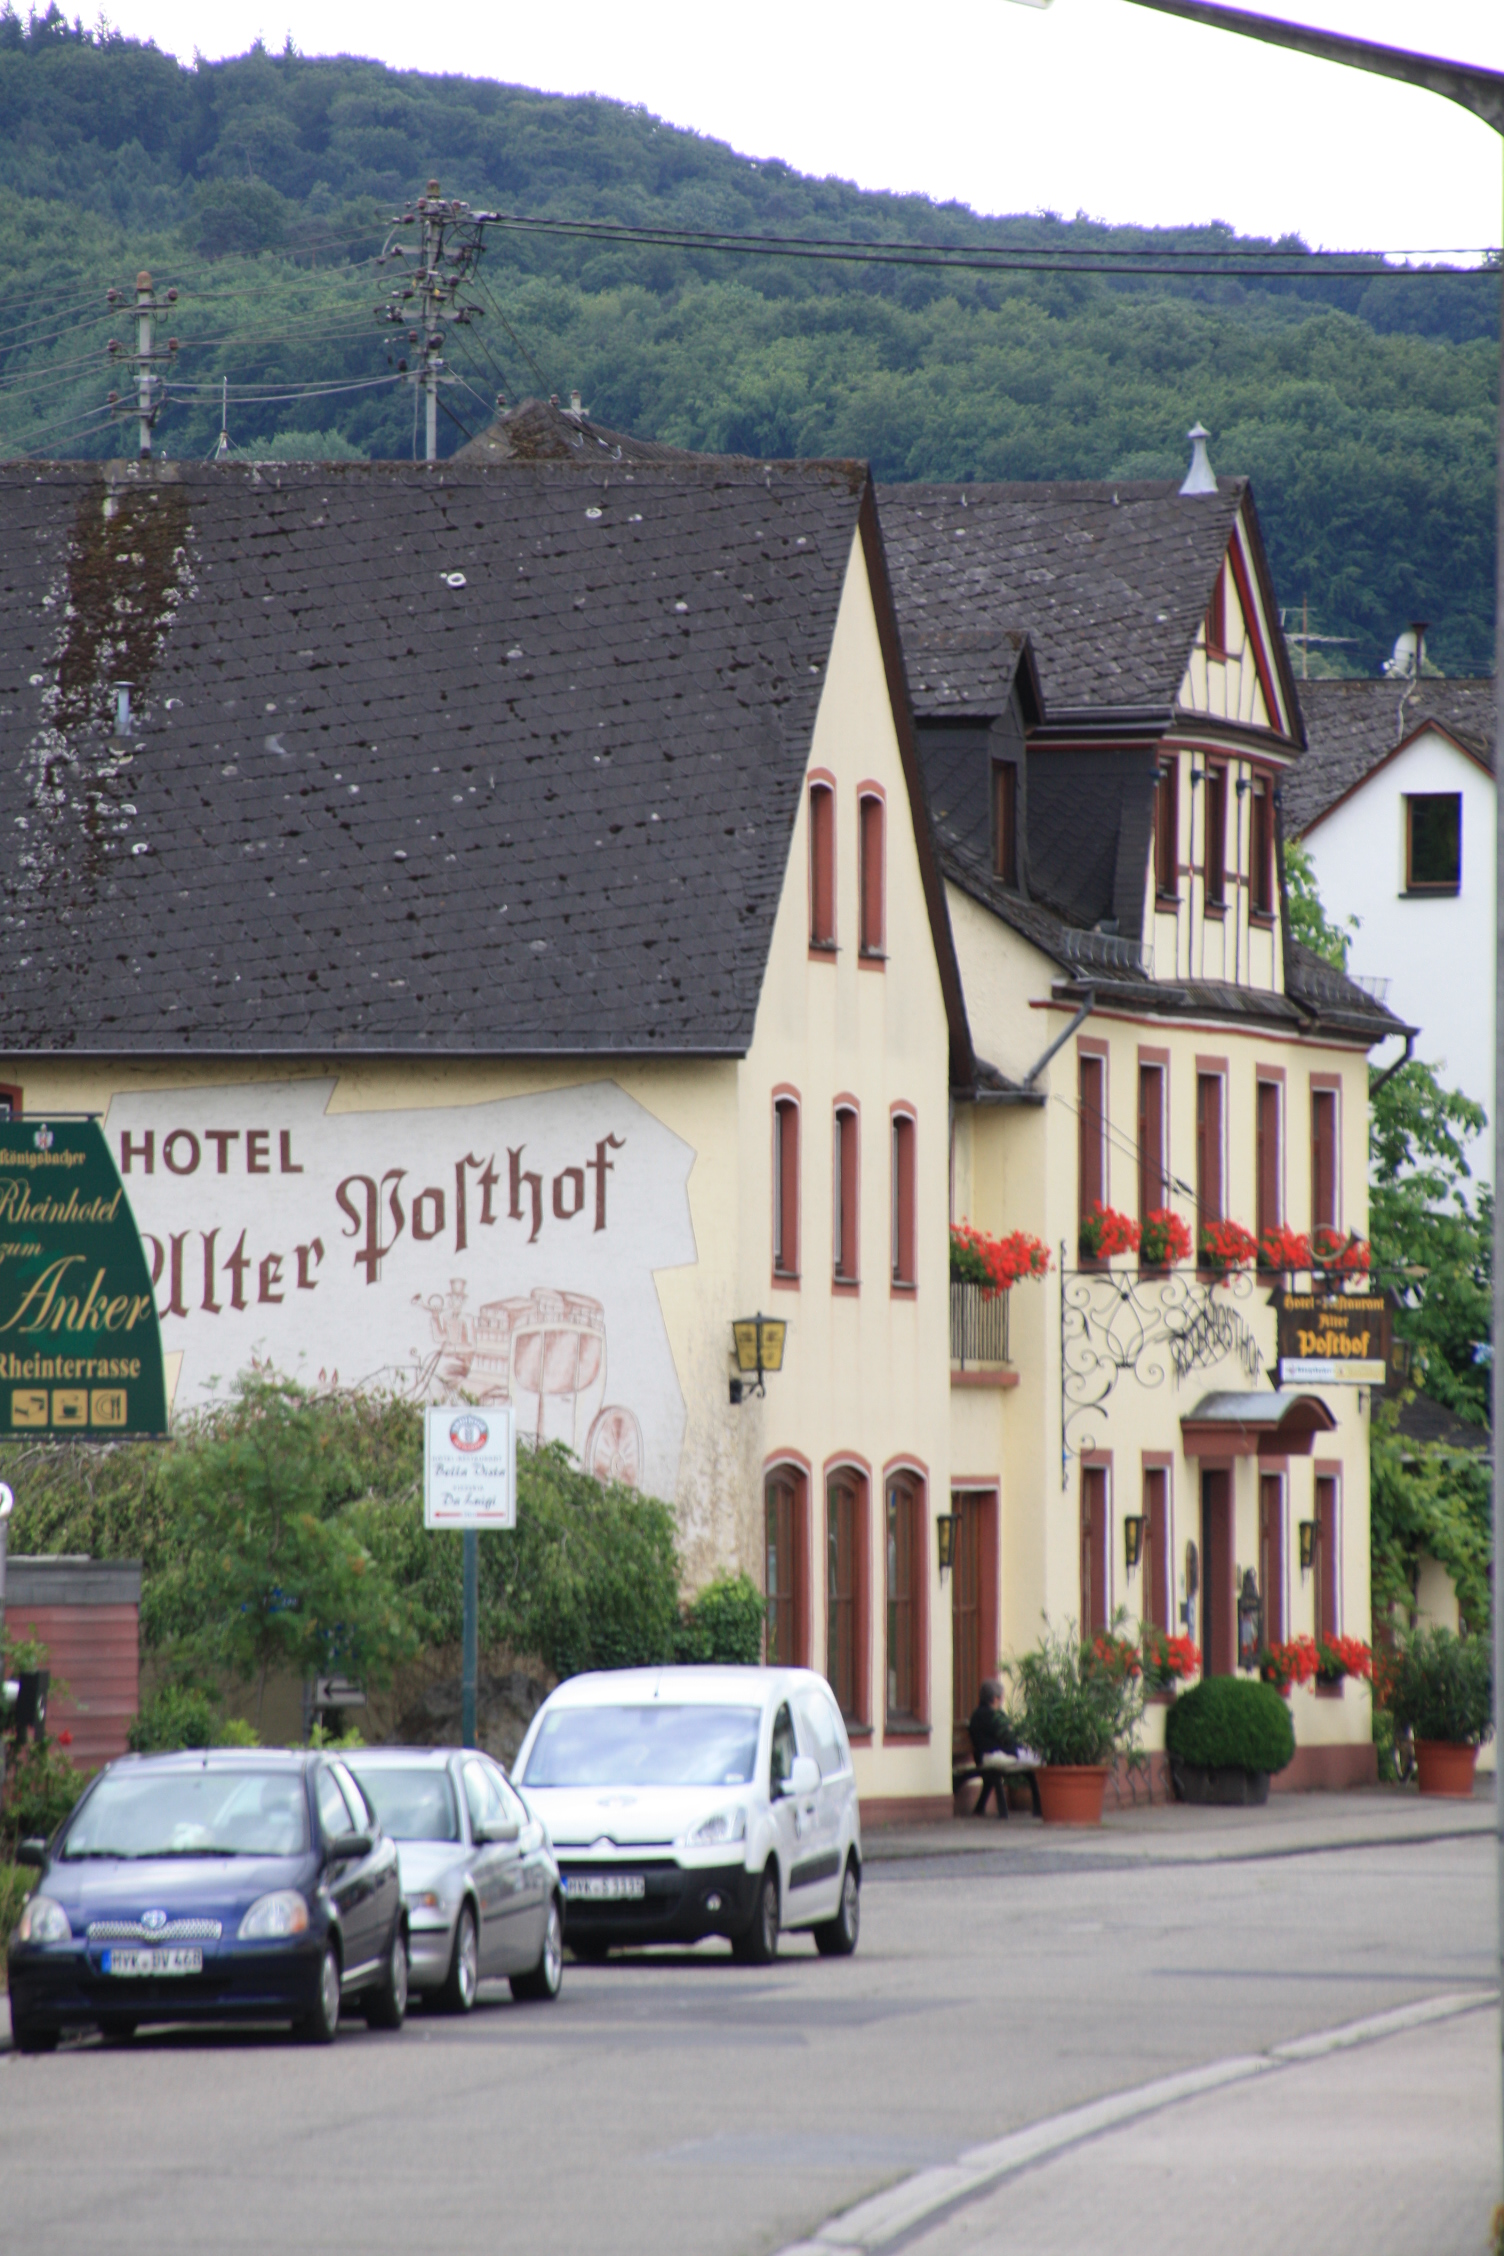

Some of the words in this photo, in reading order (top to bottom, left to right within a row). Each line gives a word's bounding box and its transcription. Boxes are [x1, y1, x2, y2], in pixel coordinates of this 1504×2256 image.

[121, 1129, 304, 1176] HOTEL
[0, 1178, 123, 1223] Rheinhotel
[0, 1255, 151, 1333] Anker
[1284, 1294, 1314, 1312] Hotel
[1318, 1314, 1349, 1330] Alter
[1296, 1329, 1371, 1358] Posthof
[0, 1352, 141, 1379] Rheinterrasse
[435, 1461, 468, 1476] Bella
[472, 1462, 506, 1476] Vista
